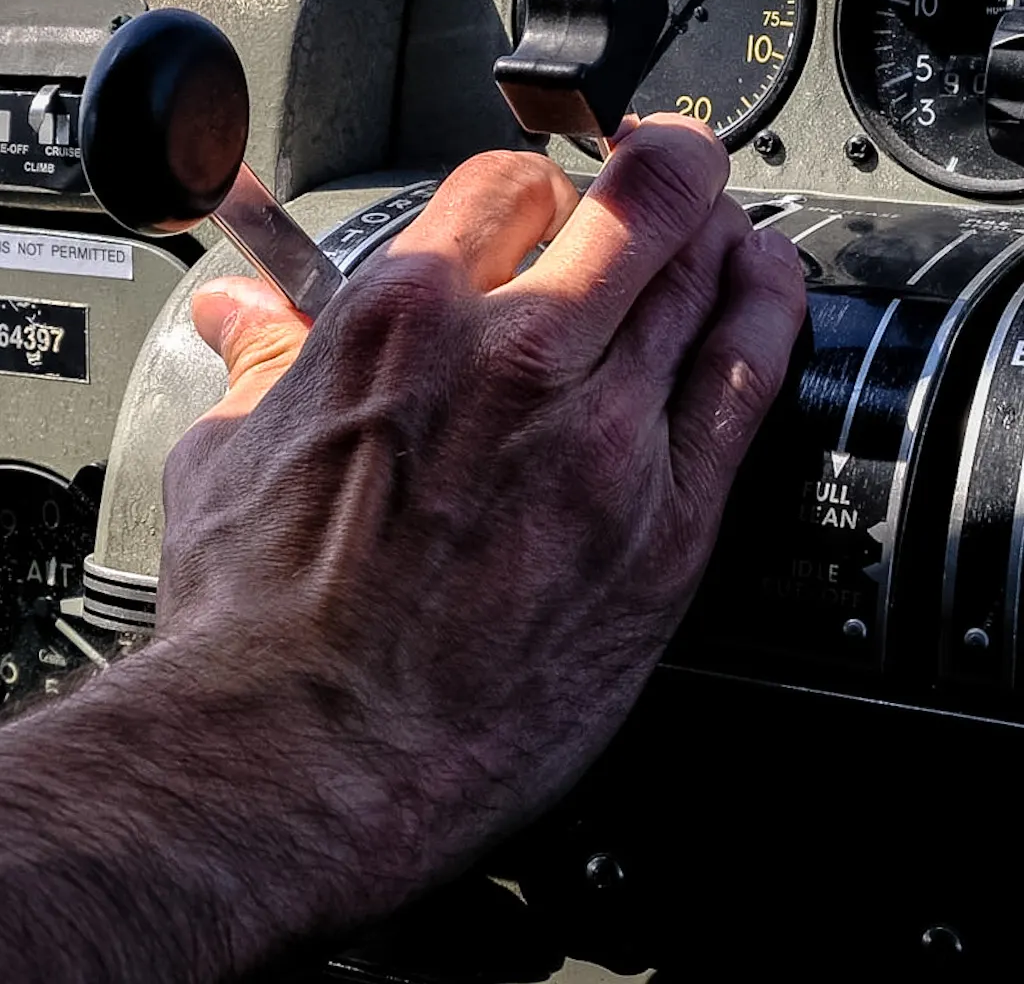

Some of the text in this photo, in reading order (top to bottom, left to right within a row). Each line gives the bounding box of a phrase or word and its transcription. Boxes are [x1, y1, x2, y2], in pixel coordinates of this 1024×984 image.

[762, 10, 780, 28] 75
[746, 34, 773, 63] 10
[915, 54, 933, 83] 5
[675, 95, 712, 124] 20
[917, 98, 937, 126] 3
[44, 146, 81, 158] CRUISE
[24, 162, 55, 174] CLIMB
[17, 242, 44, 257] NOT
[51, 244, 125, 264] PERMITTED
